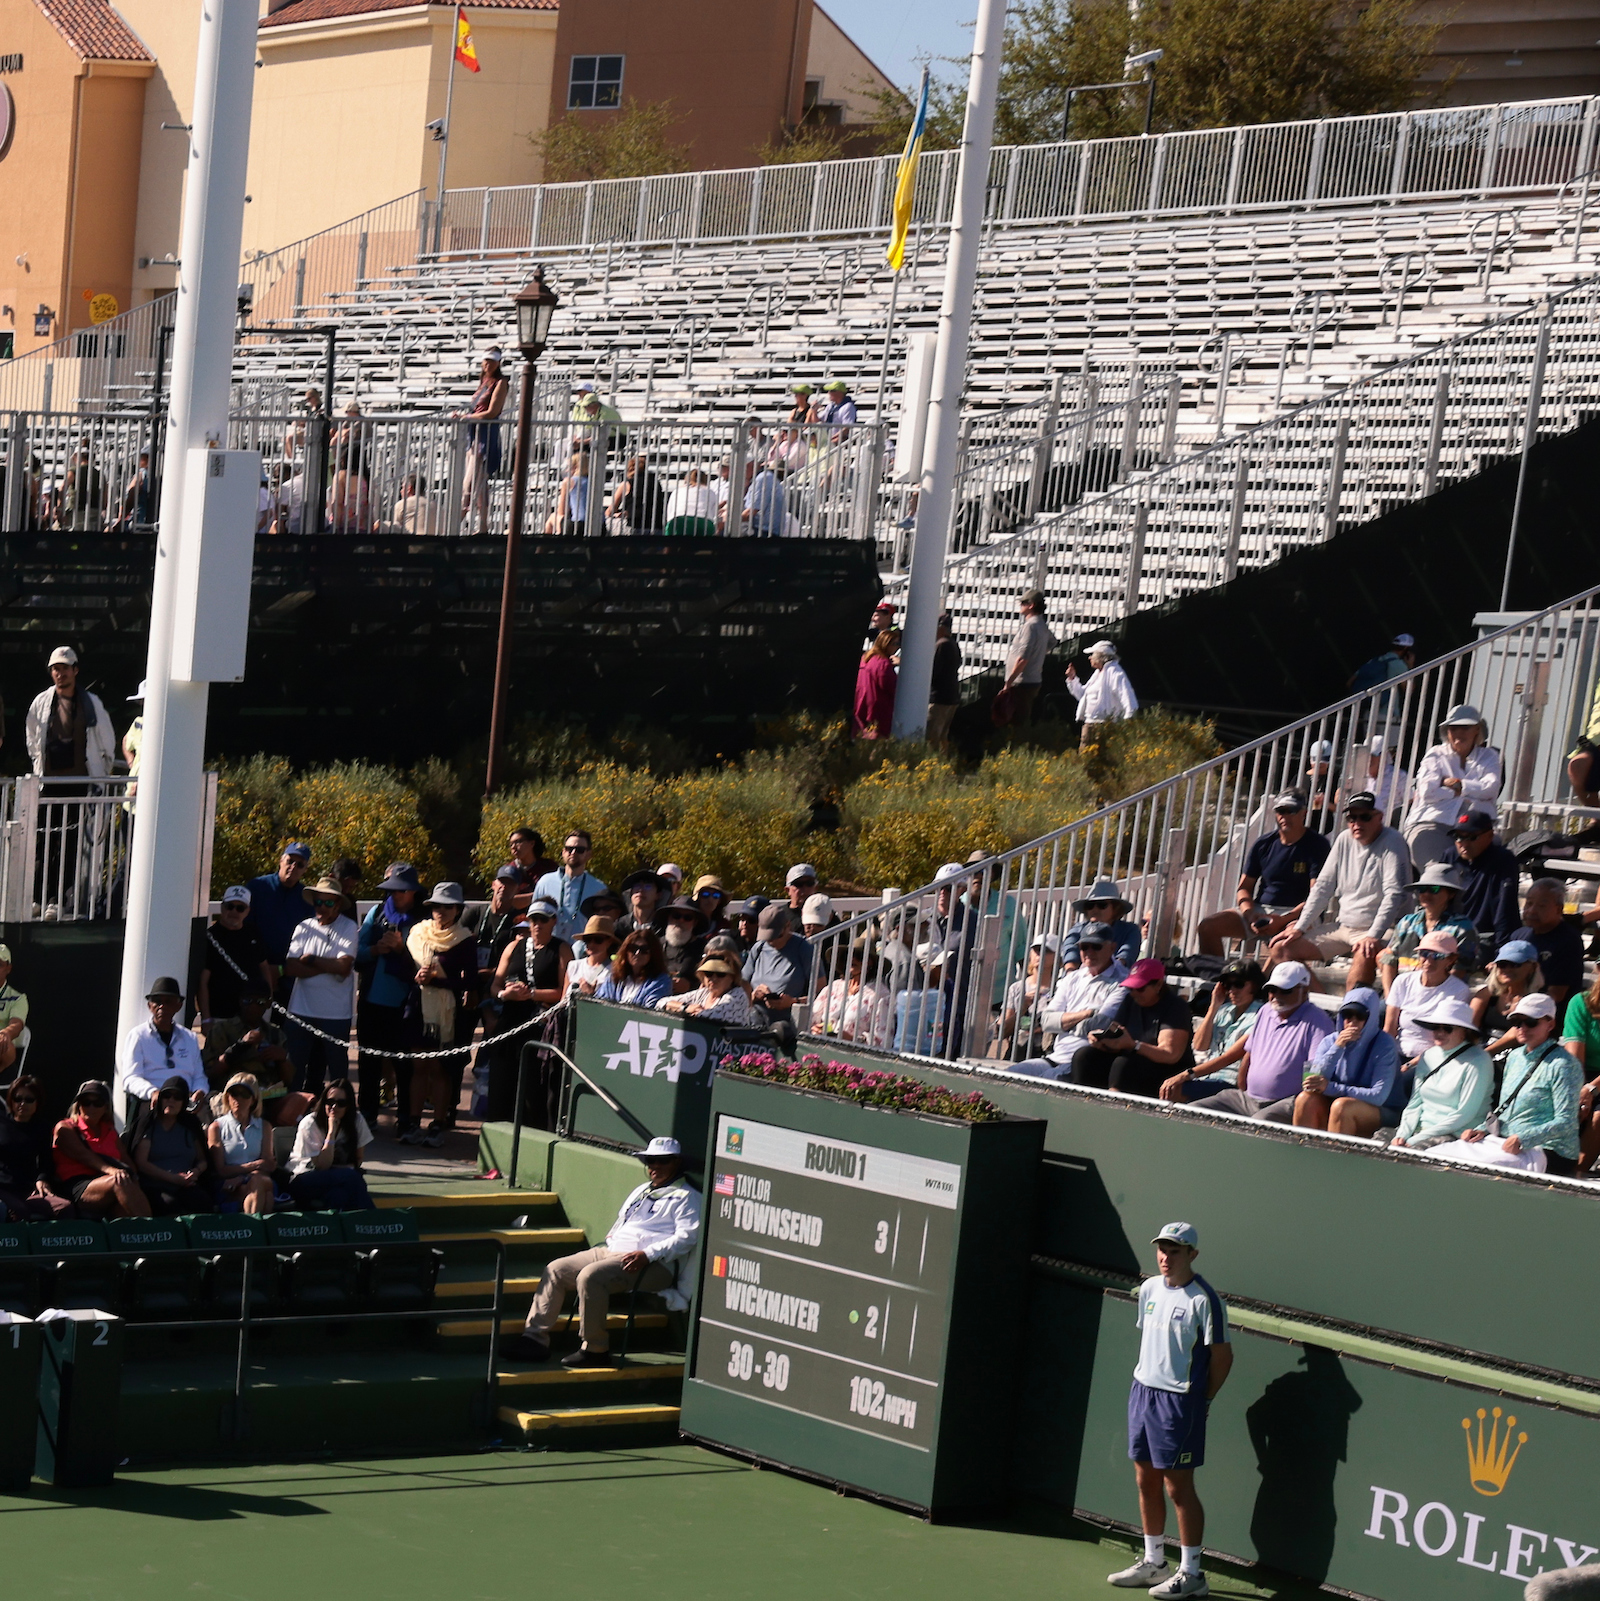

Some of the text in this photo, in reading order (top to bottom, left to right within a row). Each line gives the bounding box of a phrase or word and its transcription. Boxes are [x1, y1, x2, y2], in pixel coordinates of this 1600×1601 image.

[601, 1020, 708, 1083] ATP
[805, 1142, 867, 1181] ROUND 1
[736, 1174, 771, 1202] TAYLOR
[924, 1178, 941, 1190] WTA
[120, 1231, 172, 1243] RESERVED
[200, 1228, 252, 1240] RESERVED
[277, 1225, 329, 1238] RESERVED
[354, 1223, 404, 1235] RESERVED
[734, 1198, 823, 1247] TOWNSEND
[874, 1220, 888, 1254] 3
[41, 1235, 94, 1247] RESERVED
[727, 1255, 761, 1285] YANINA
[725, 1279, 879, 1339] WICKMAYER 2
[10, 1324, 21, 1349] 1
[92, 1321, 110, 1346] 2
